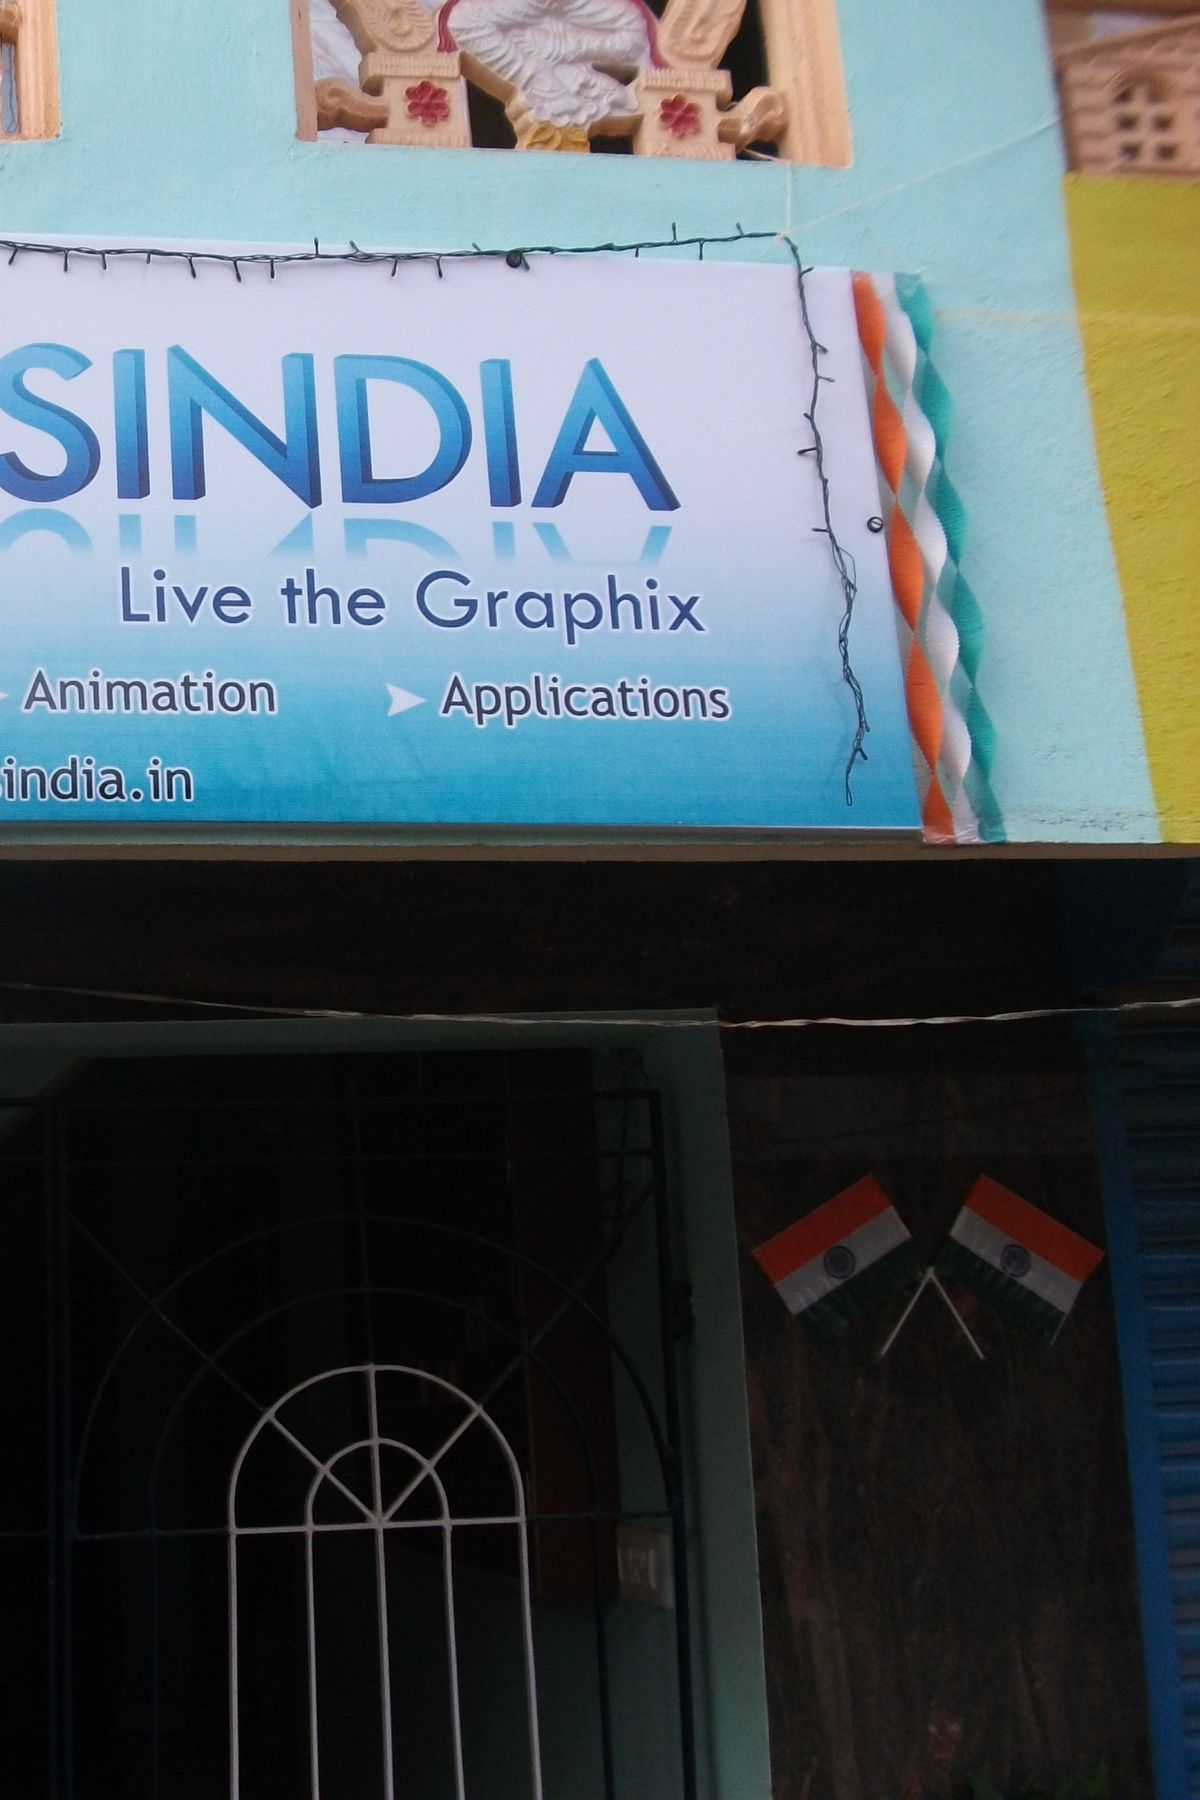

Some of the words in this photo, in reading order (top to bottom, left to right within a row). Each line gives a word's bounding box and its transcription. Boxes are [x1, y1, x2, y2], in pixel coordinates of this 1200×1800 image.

[121, 567, 252, 623] Live
[281, 569, 386, 627] the
[417, 570, 706, 645] Graphix
[23, 670, 277, 713] Animation
[441, 674, 731, 727] Applications
